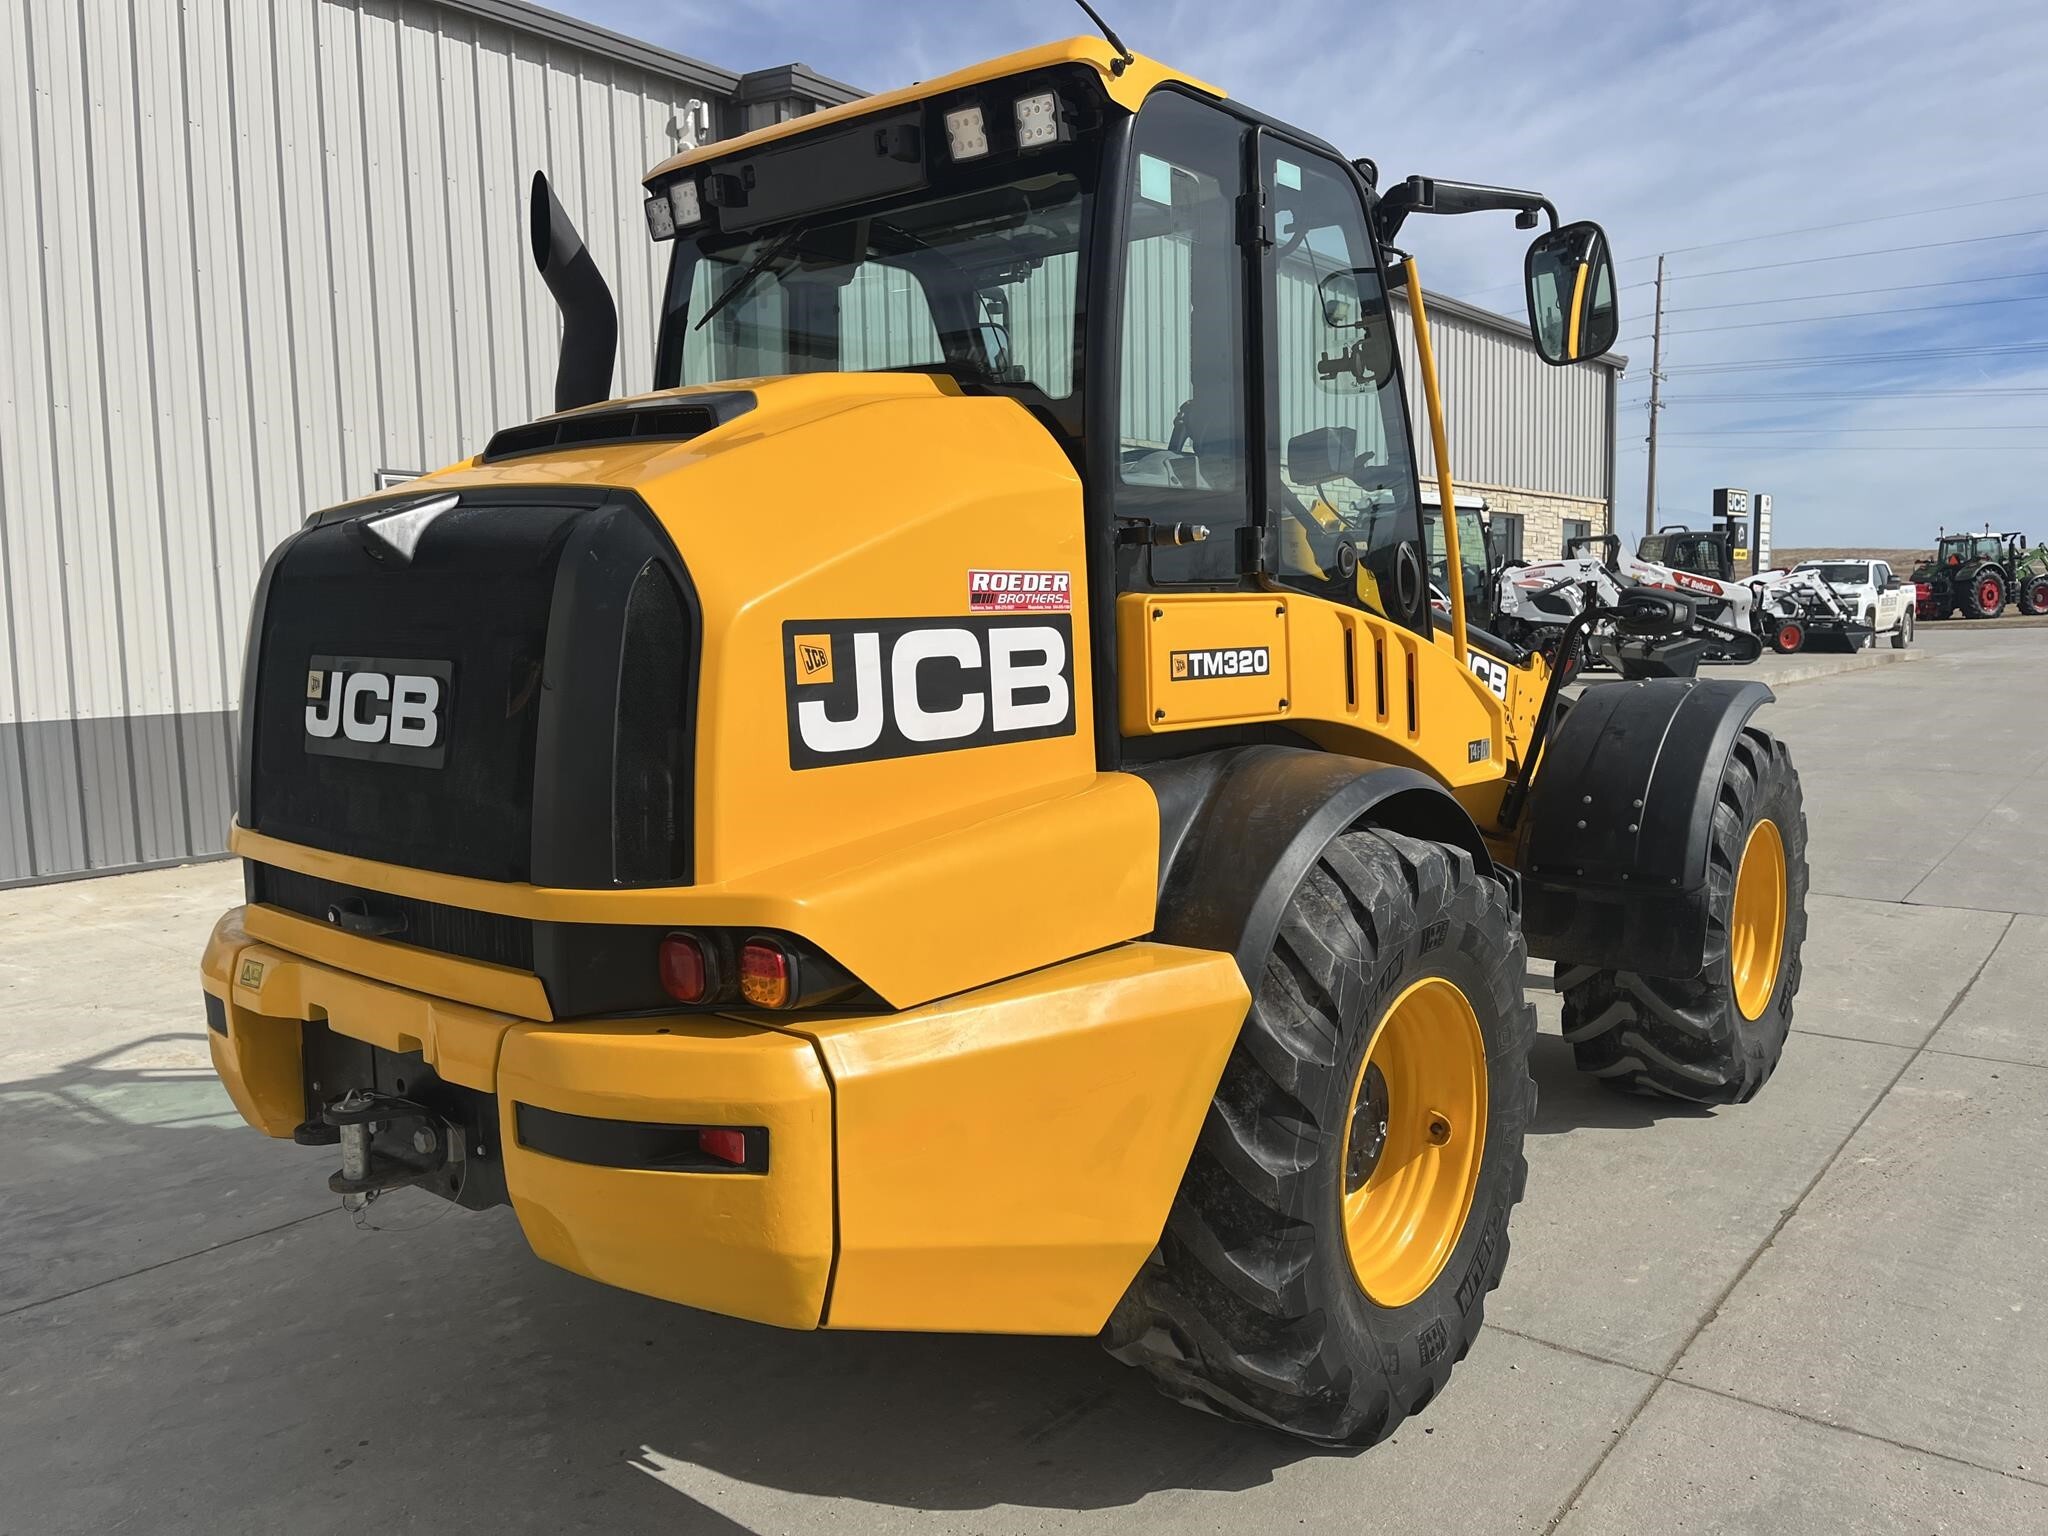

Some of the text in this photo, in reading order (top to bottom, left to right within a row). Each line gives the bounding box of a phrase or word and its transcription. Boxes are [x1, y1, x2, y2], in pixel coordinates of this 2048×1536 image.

[1728, 492, 1747, 512] JCB
[971, 573, 1068, 592] ROEDER
[1690, 579, 1714, 593] Bobcat
[997, 593, 1064, 604] BROTHERS
[804, 647, 827, 671] JCB
[1188, 649, 1268, 677] TM320
[798, 626, 1069, 752] JCB
[305, 671, 440, 748] JCB
